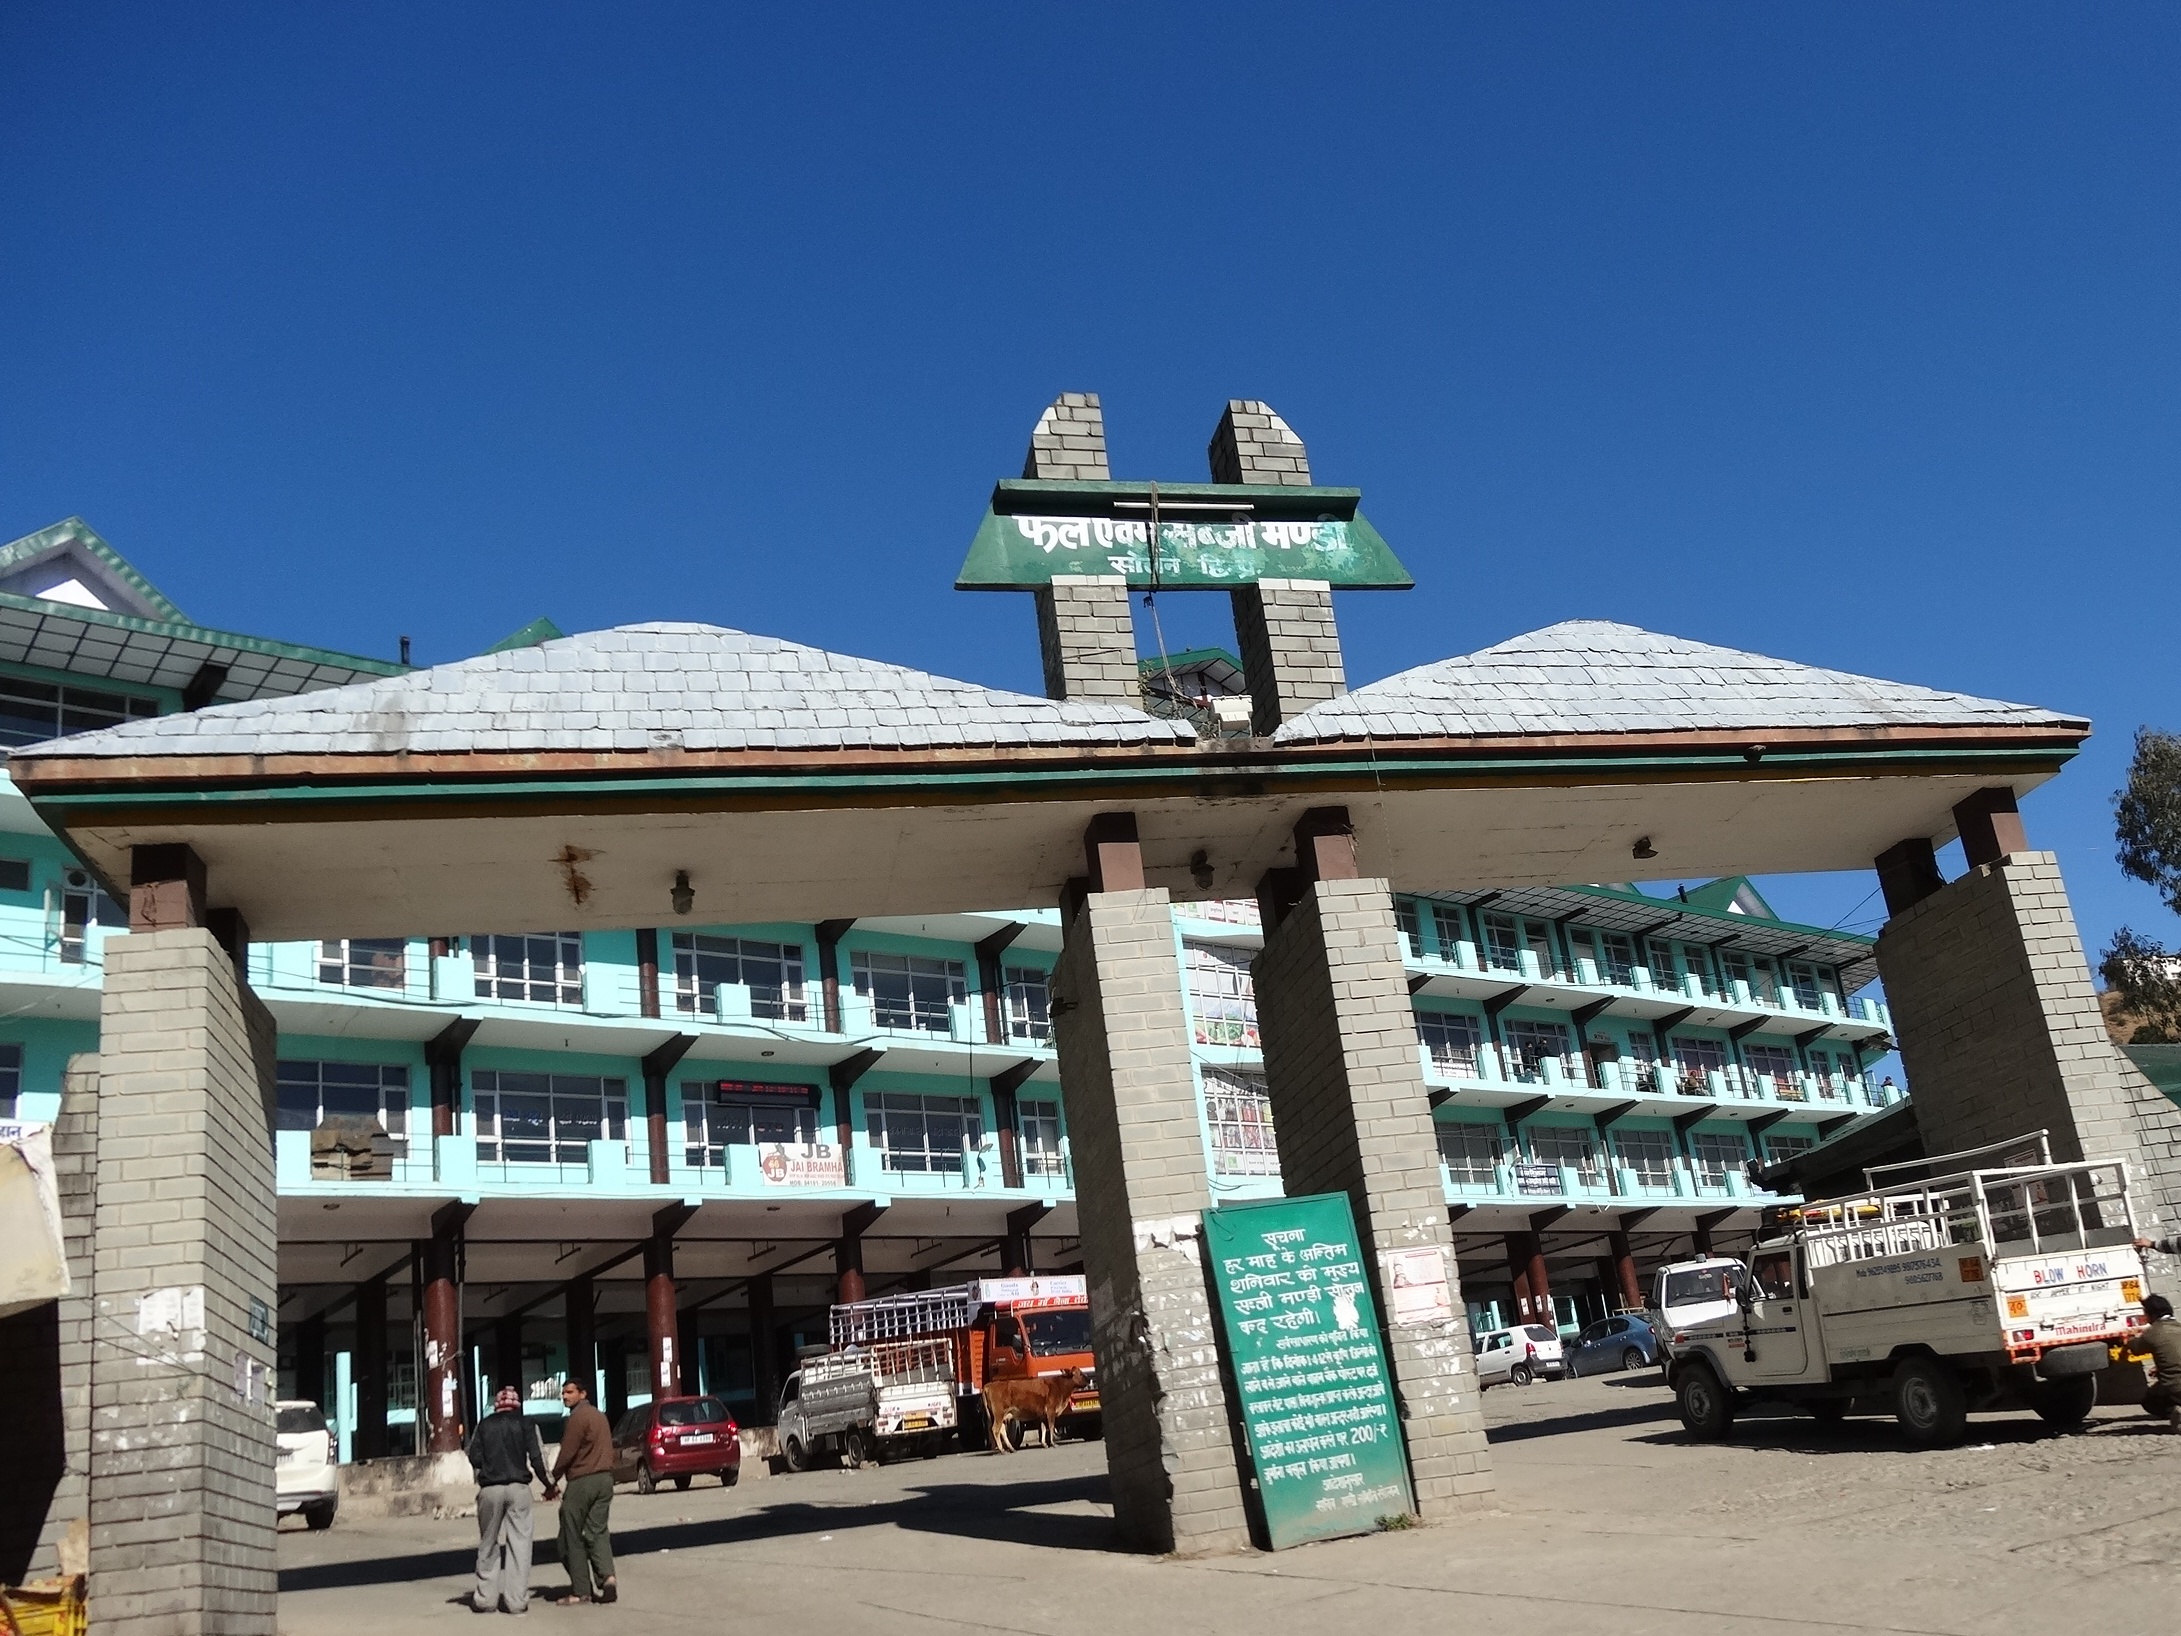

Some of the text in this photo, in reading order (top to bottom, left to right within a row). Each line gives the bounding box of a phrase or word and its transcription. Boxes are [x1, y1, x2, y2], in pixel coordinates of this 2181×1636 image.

[1011, 514, 1091, 553] फल
[801, 1143, 831, 1158] JB
[767, 1168, 785, 1178] JB
[791, 1161, 844, 1173] JAI BRAMHA
[1261, 1229, 1306, 1250] सूचना
[1223, 1243, 1347, 1274] हर माह के अन्तिम
[1230, 1261, 1360, 1294] शनिवार को मुख्य
[2033, 1263, 2108, 1284] BLOW HORN
[1278, 1285, 1322, 1304] मण्डी
[2055, 1322, 2107, 1336] Mahindra
